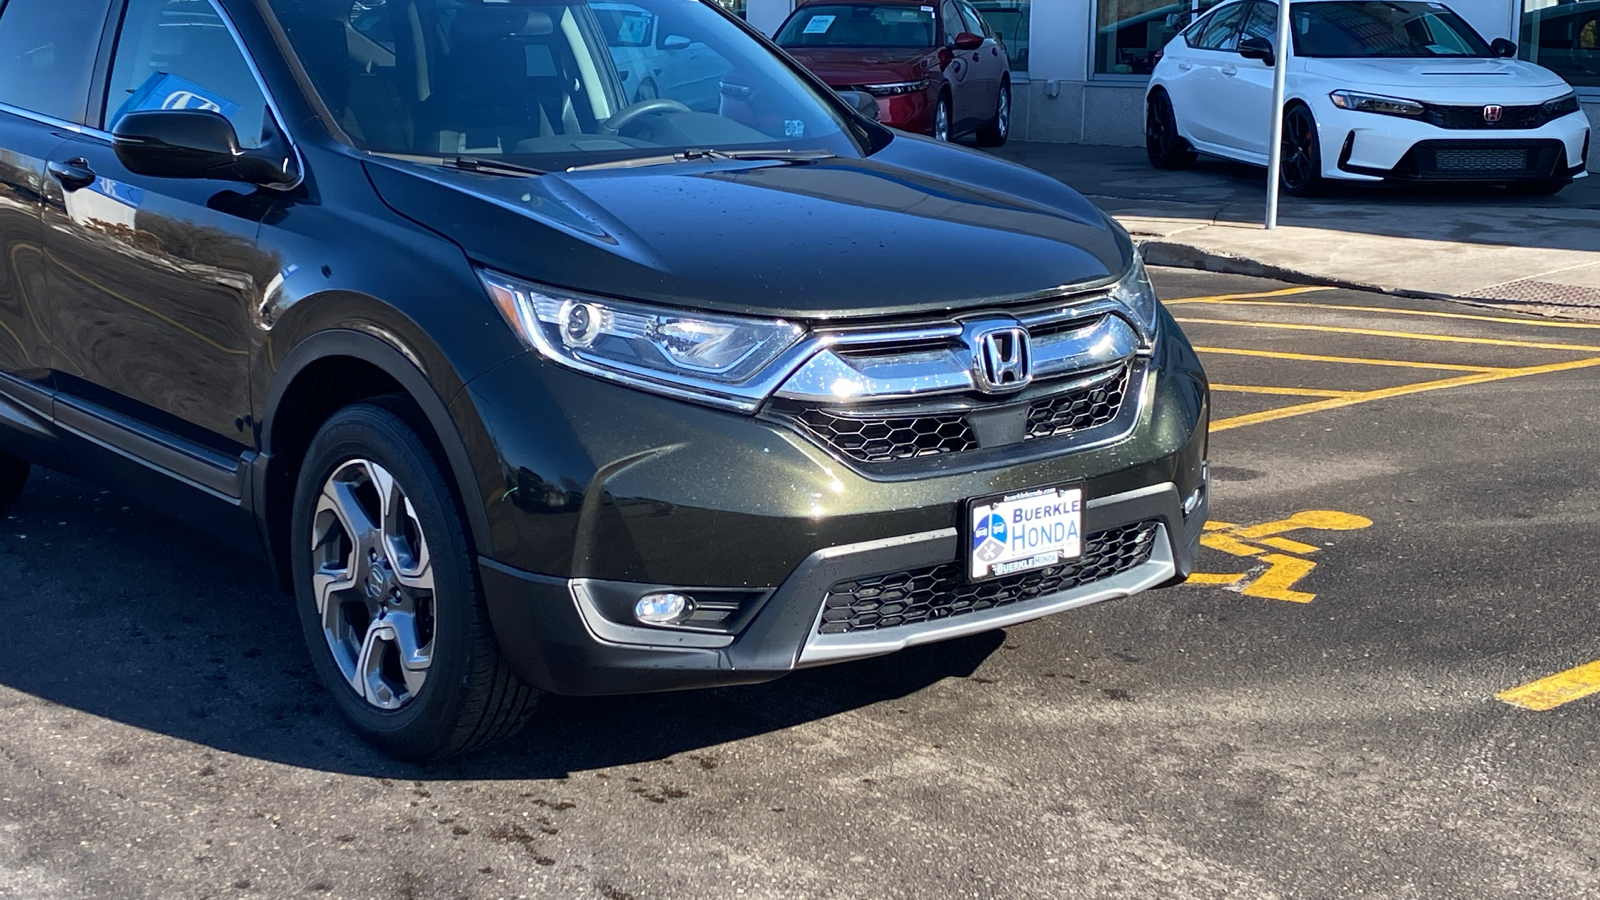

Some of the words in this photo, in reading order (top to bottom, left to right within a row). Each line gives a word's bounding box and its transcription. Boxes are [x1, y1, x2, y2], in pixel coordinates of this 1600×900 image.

[1013, 500, 1080, 524] BUERKLE
[1012, 519, 1079, 552] HONDA
[997, 557, 1034, 574] BUERKLE
